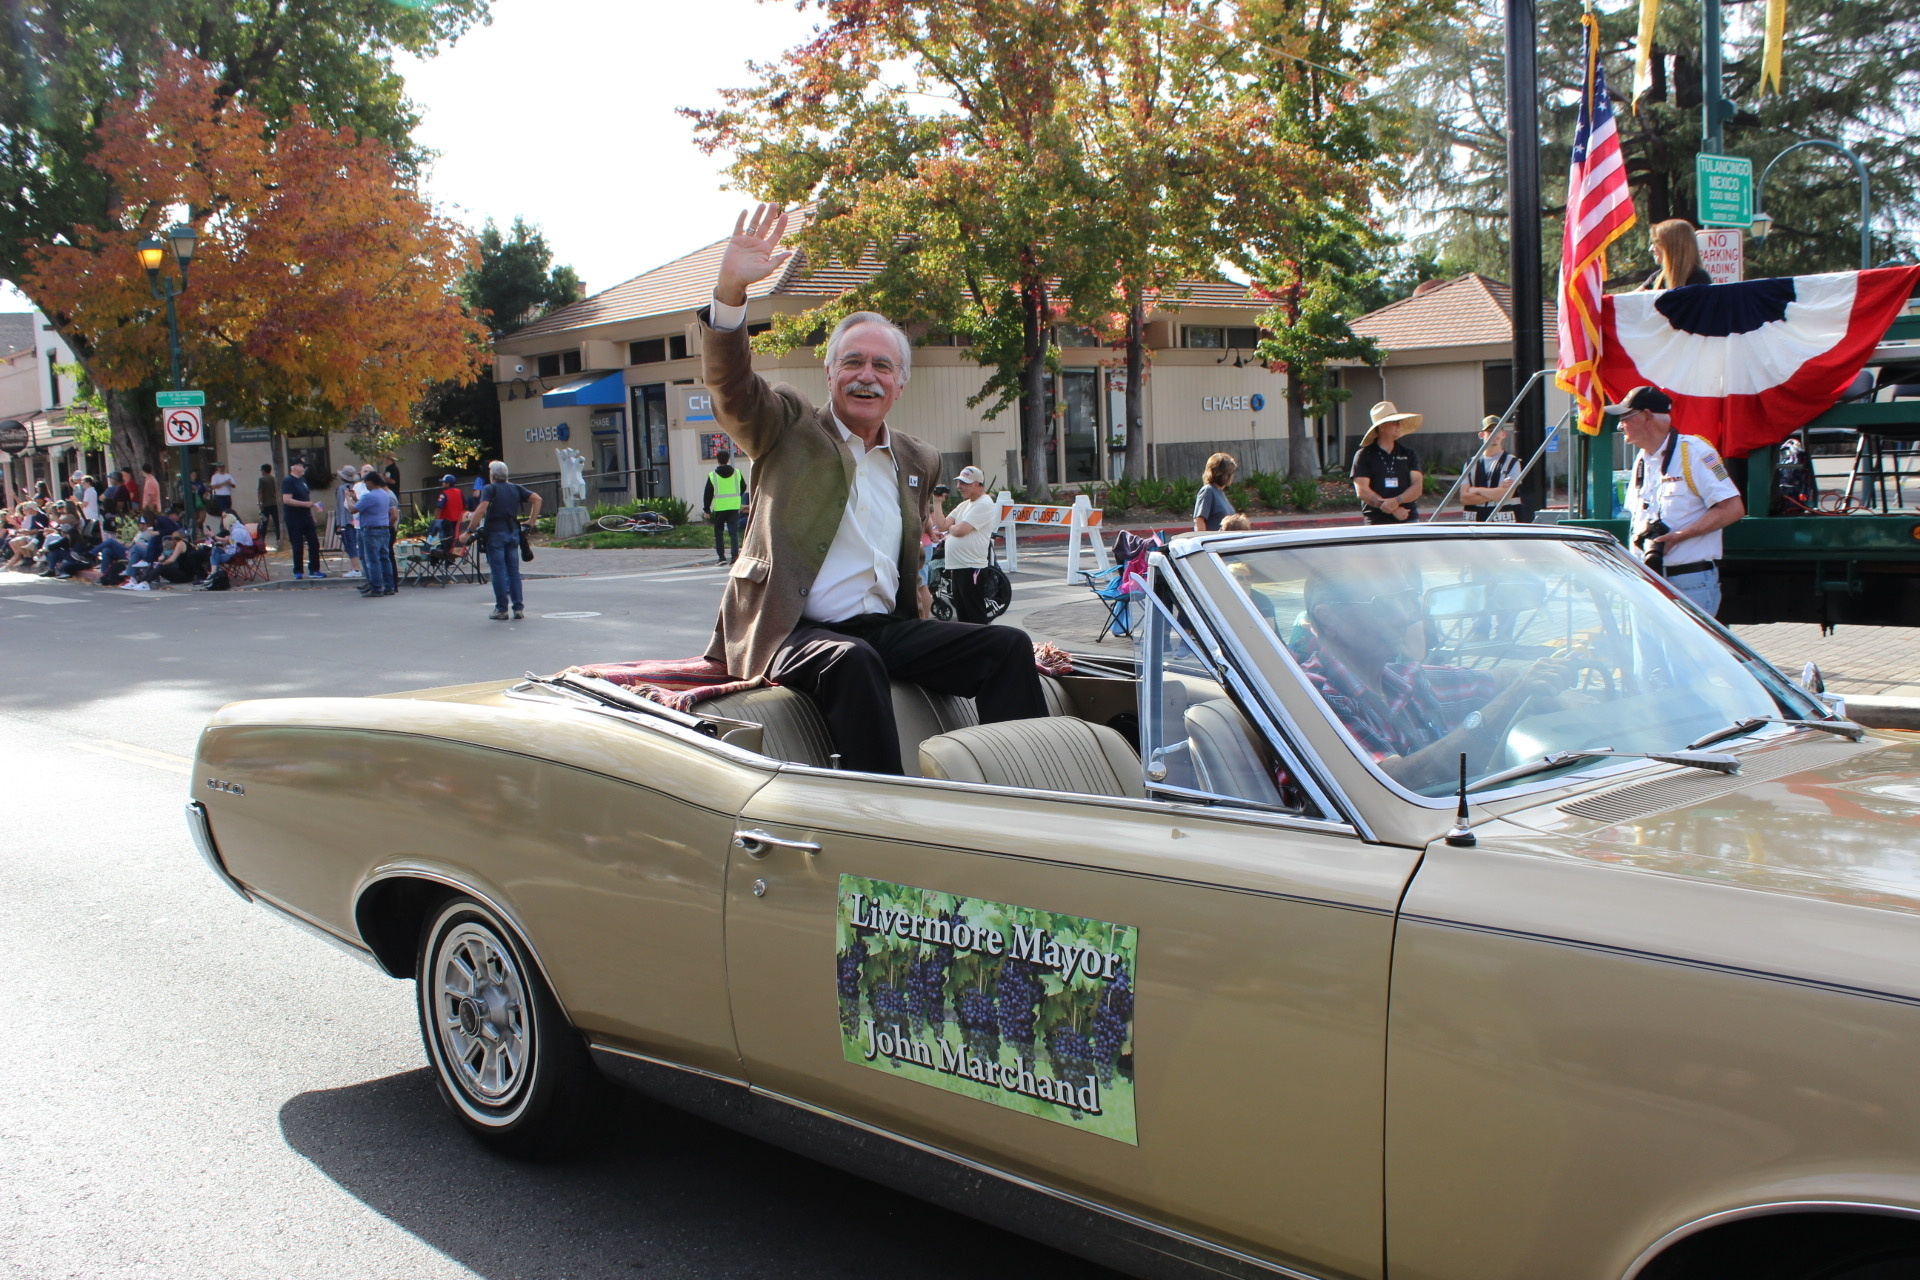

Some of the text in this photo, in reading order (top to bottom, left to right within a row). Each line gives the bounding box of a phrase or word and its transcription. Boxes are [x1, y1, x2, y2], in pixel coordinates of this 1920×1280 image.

[1701, 159, 1749, 176] TULANCINGO
[1710, 176, 1739, 190] MEXICO
[1708, 234, 1727, 247] NO
[1704, 262, 1736, 274] OADING
[1202, 396, 1249, 411] CHASE
[591, 417, 610, 428] CHASE
[524, 425, 559, 442] CHASE
[1012, 509, 1060, 522] ROAD CLOSED
[207, 777, 245, 796] GTO
[851, 893, 1121, 984] Livermore Mayor
[864, 1019, 1102, 1115] John Marchand
